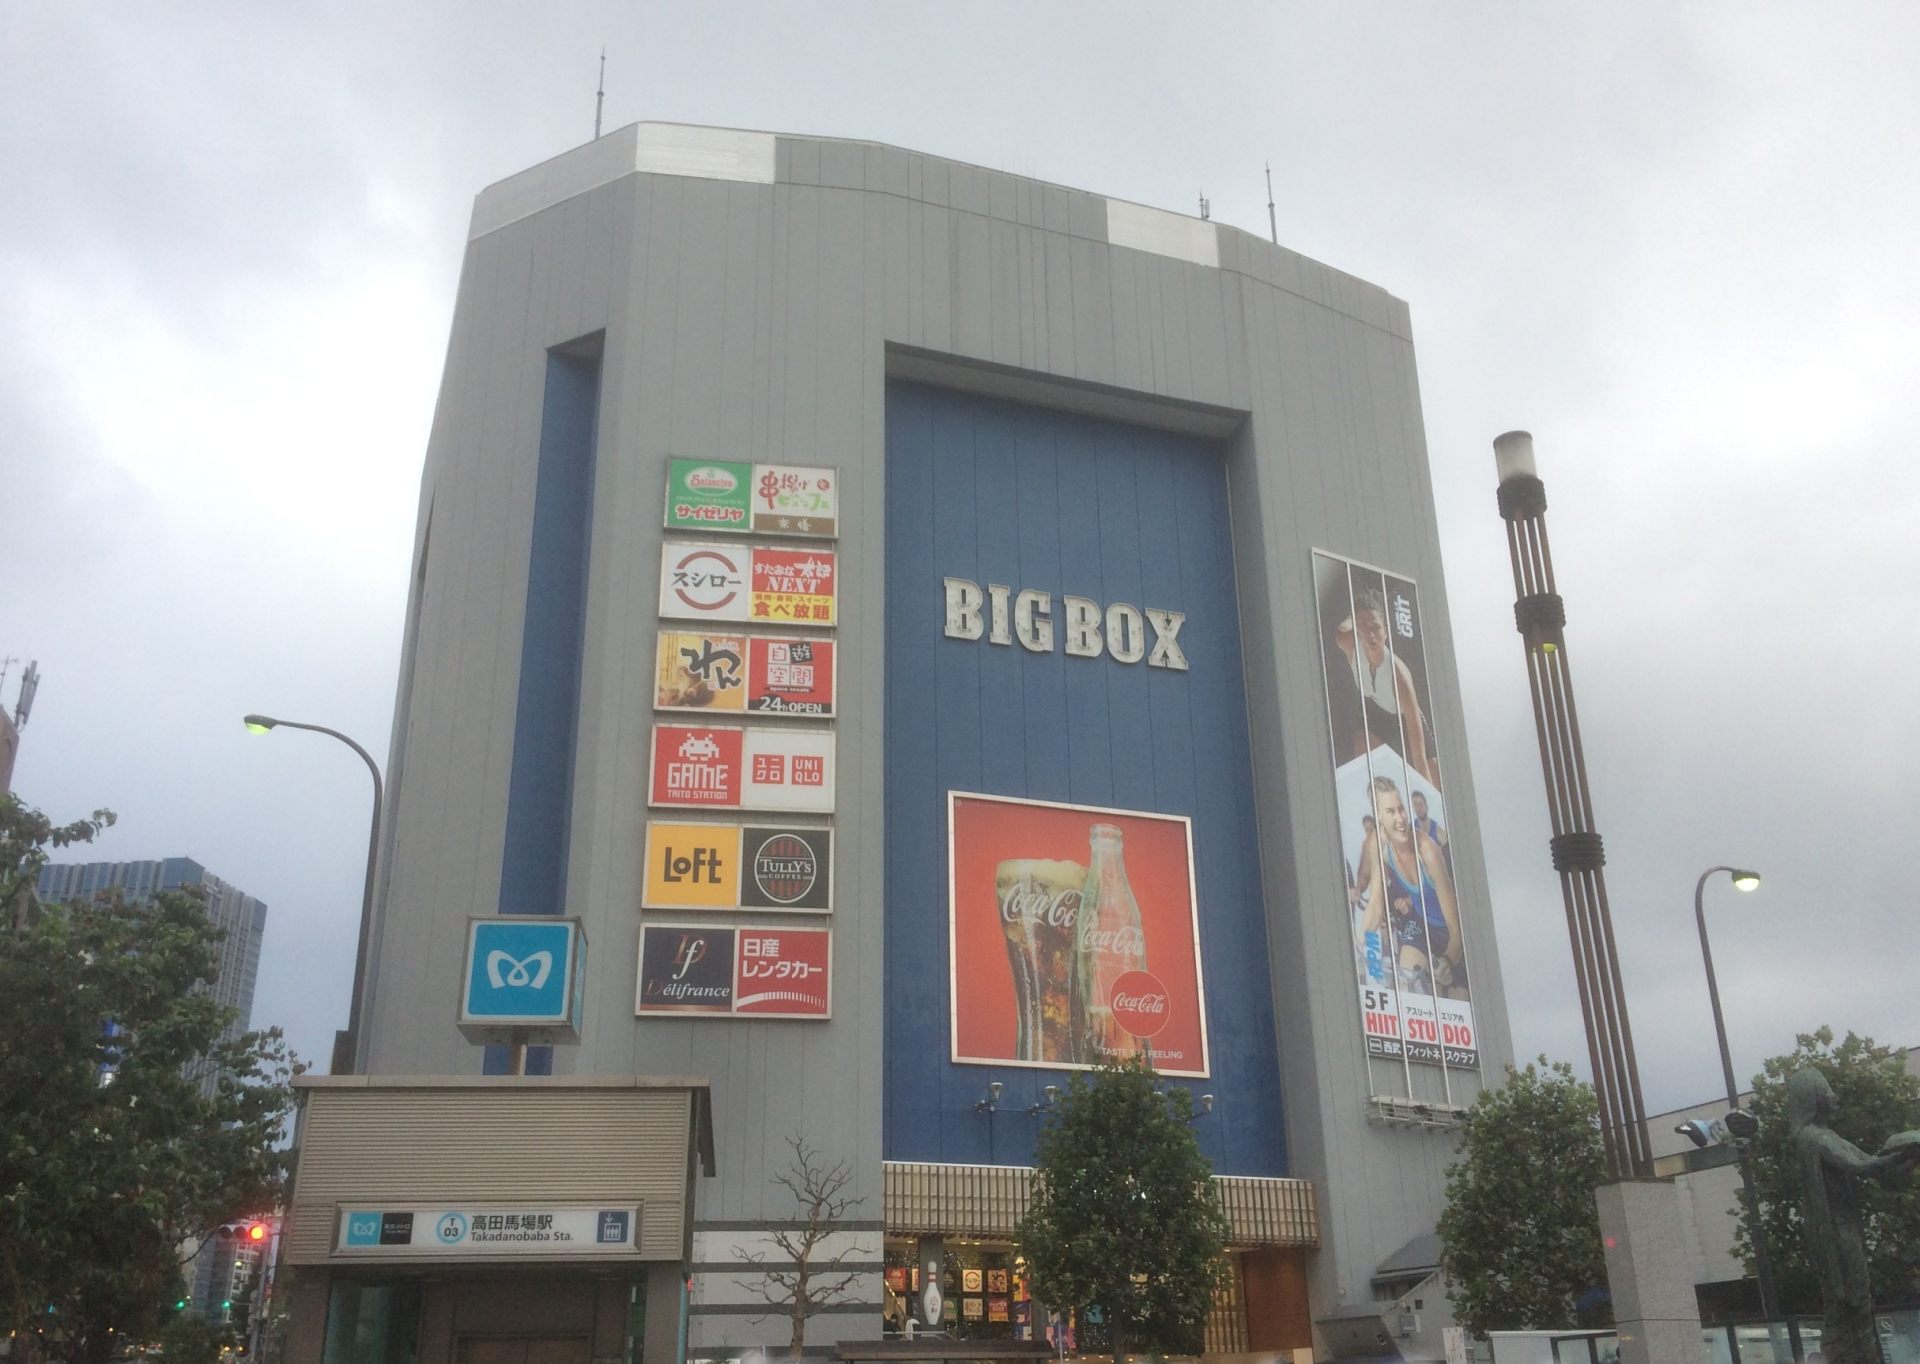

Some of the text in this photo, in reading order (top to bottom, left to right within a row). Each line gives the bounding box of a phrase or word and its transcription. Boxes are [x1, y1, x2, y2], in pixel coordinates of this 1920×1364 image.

[676, 505, 744, 522] サイゼリヤ
[671, 571, 742, 588] スシロー
[766, 576, 821, 593] NEXT
[753, 601, 830, 620] 食べ放題
[943, 577, 1189, 671] BIG BOX
[681, 639, 742, 689] わん
[789, 702, 822, 713] OPEN
[795, 759, 817, 770] UNI
[668, 763, 728, 790] GAME
[795, 772, 820, 783] QLO
[667, 789, 727, 800] TAITO STATION
[743, 938, 780, 958] 日産
[1365, 931, 1384, 983] RPM
[742, 960, 823, 979] レンタカー
[1366, 1011, 1398, 1036] HIIT
[1148, 1049, 1184, 1060] FEELING
[448, 1218, 456, 1227] T
[471, 1214, 553, 1231] 高田馬場駅
[444, 1227, 459, 1237] 03
[471, 1230, 574, 1243] Takadanobaba Sta.
